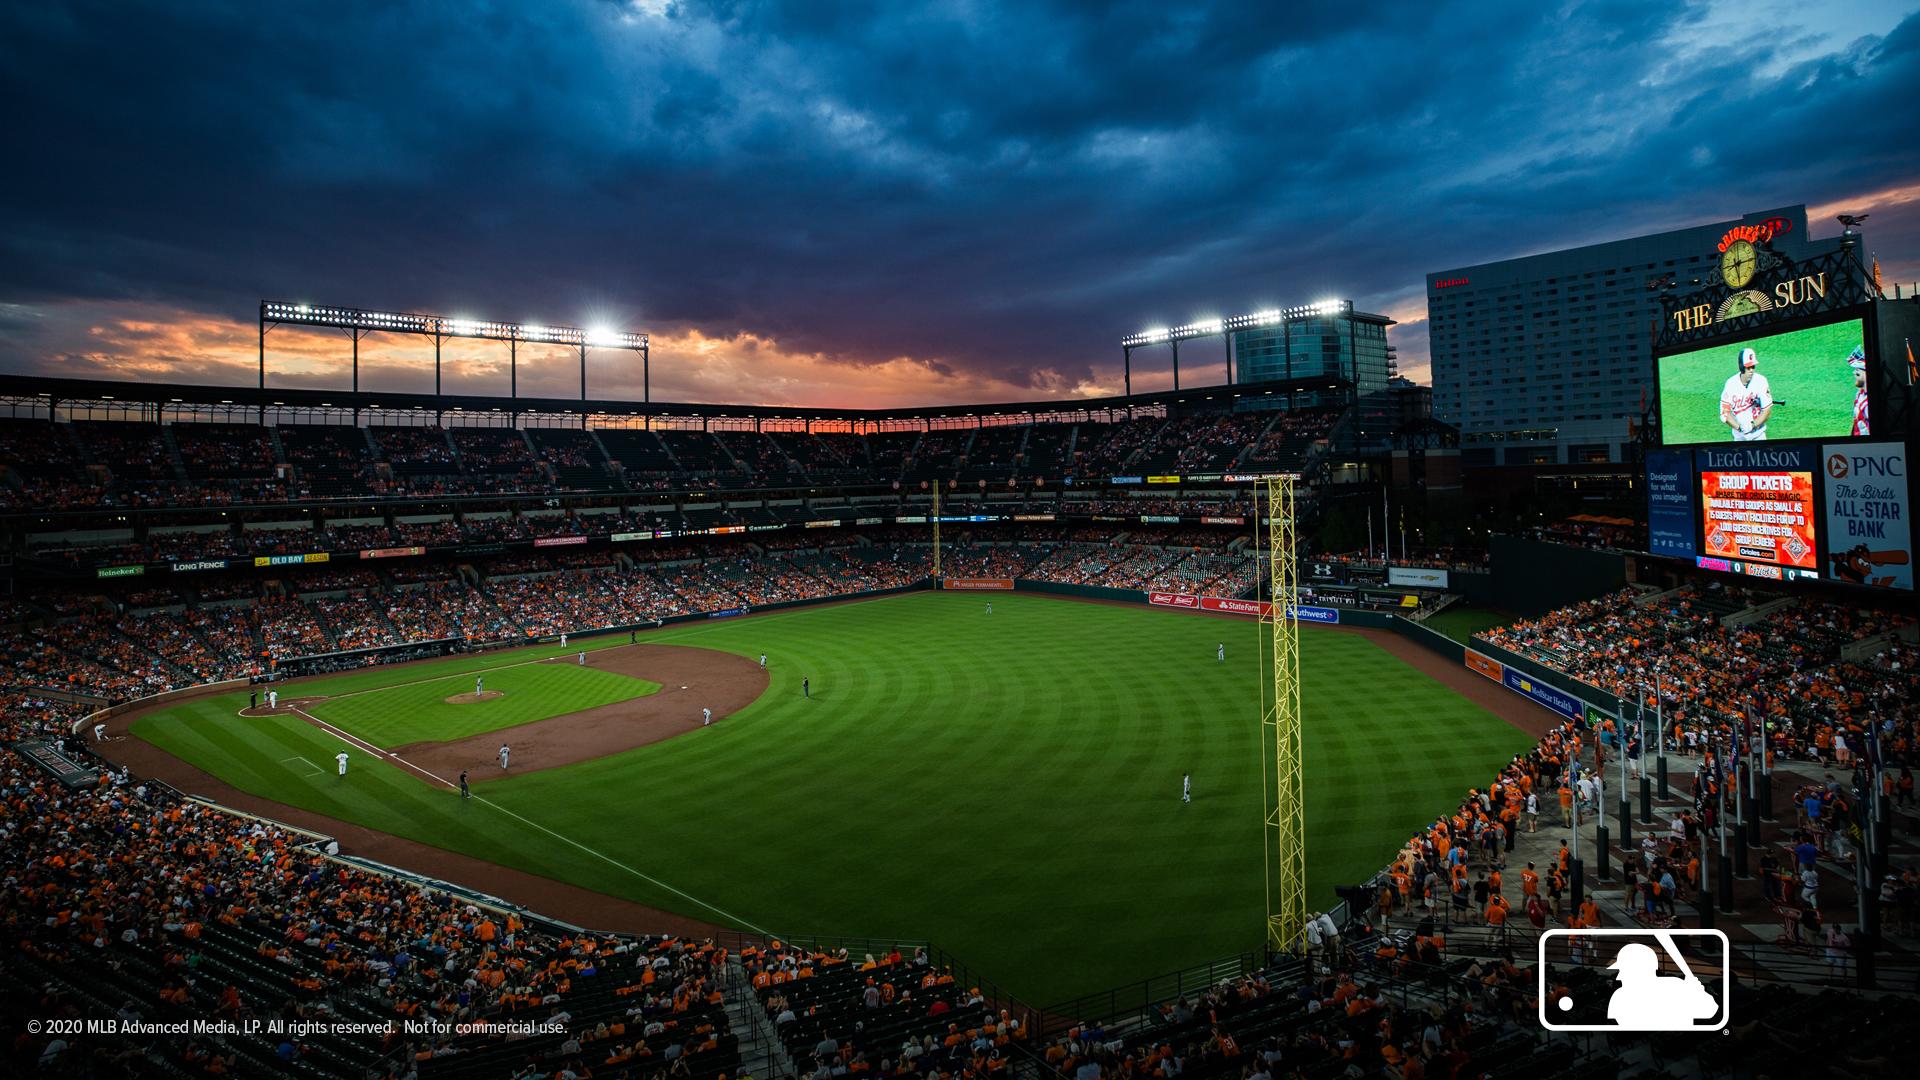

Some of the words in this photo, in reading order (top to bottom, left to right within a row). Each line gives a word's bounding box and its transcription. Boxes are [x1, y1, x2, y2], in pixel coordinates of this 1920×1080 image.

[1673, 303, 1712, 333] THE
[1774, 272, 1826, 309] SUN
[1708, 451, 1742, 467] LEGG
[1746, 450, 1800, 467] MASON
[1853, 456, 1903, 476] PNC
[1650, 472, 1678, 483] Designed
[1719, 475, 1750, 490] GROUP
[1750, 475, 1793, 491] TICKETS
[1660, 483, 1676, 491] what
[1836, 484, 1859, 498] The
[1860, 484, 1895, 500] Birds
[1651, 494, 1662, 502] you
[1663, 492, 1688, 503] imagine
[1834, 500, 1900, 520] ALL-STAR
[1848, 520, 1886, 539] BANK
[173, 563, 197, 571] LONG
[198, 561, 225, 570] FENCE
[272, 556, 287, 565] OLD
[288, 555, 303, 564] BAY
[98, 568, 135, 577] Heineken
[1734, 562, 1741, 572] 0
[1788, 570, 1795, 580] 0
[1287, 607, 1328, 619] Suthwest
[1532, 686, 1554, 703] MedStar
[1553, 696, 1573, 712] Health
